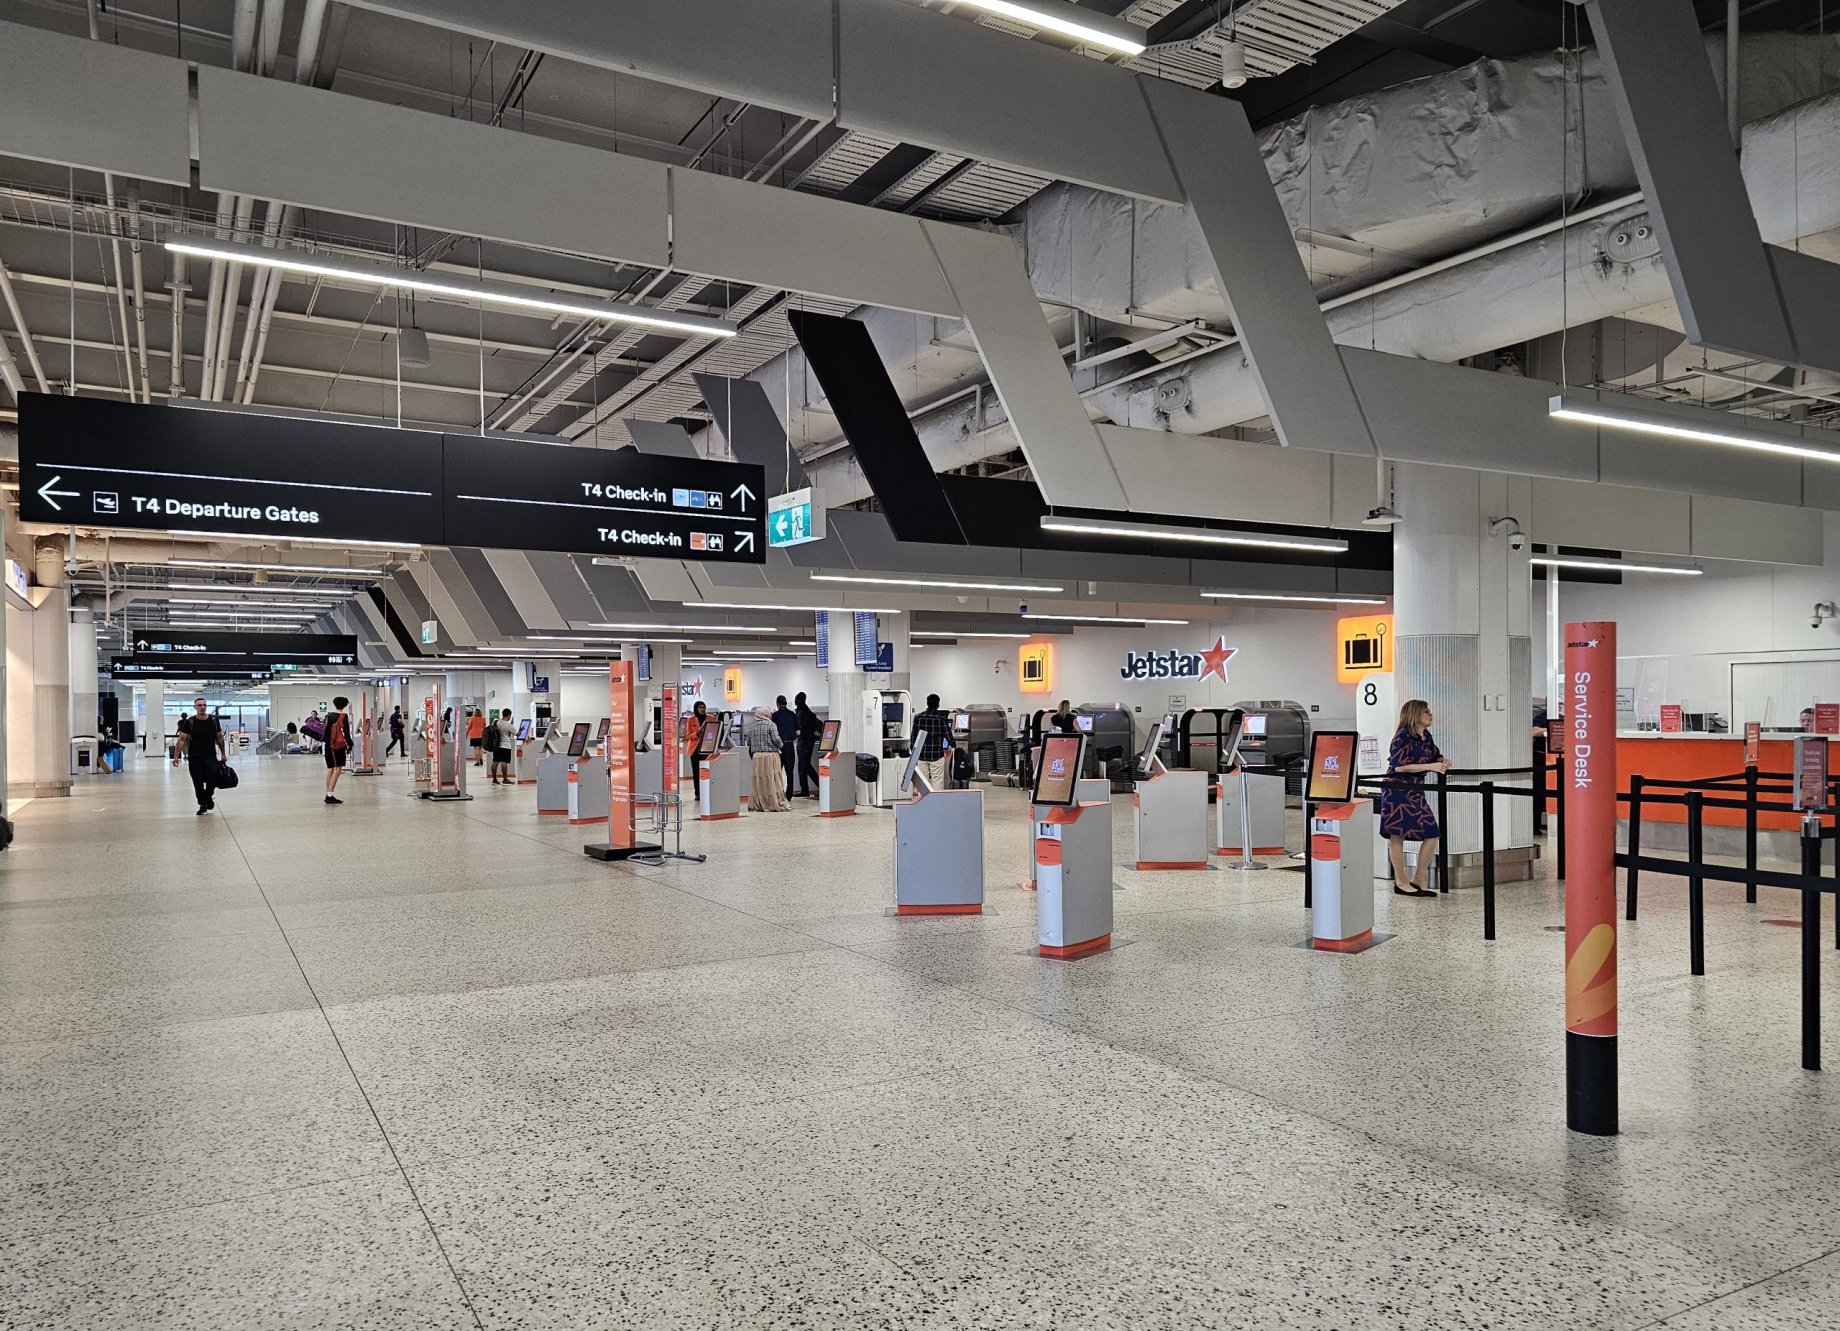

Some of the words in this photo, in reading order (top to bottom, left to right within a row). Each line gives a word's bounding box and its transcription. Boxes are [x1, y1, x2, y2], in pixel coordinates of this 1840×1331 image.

[581, 482, 602, 497] T4
[606, 484, 667, 503] Check-in
[131, 496, 160, 513] T4
[165, 498, 261, 519] Departure
[265, 505, 319, 523] Gates
[598, 528, 618, 542] T4
[621, 530, 682, 547] Check-in
[1120, 650, 1202, 679] Jetstar
[873, 696, 879, 710] 7
[1364, 683, 1377, 706] 8
[1575, 672, 1592, 739] Service
[1575, 745, 1592, 788] Desk
